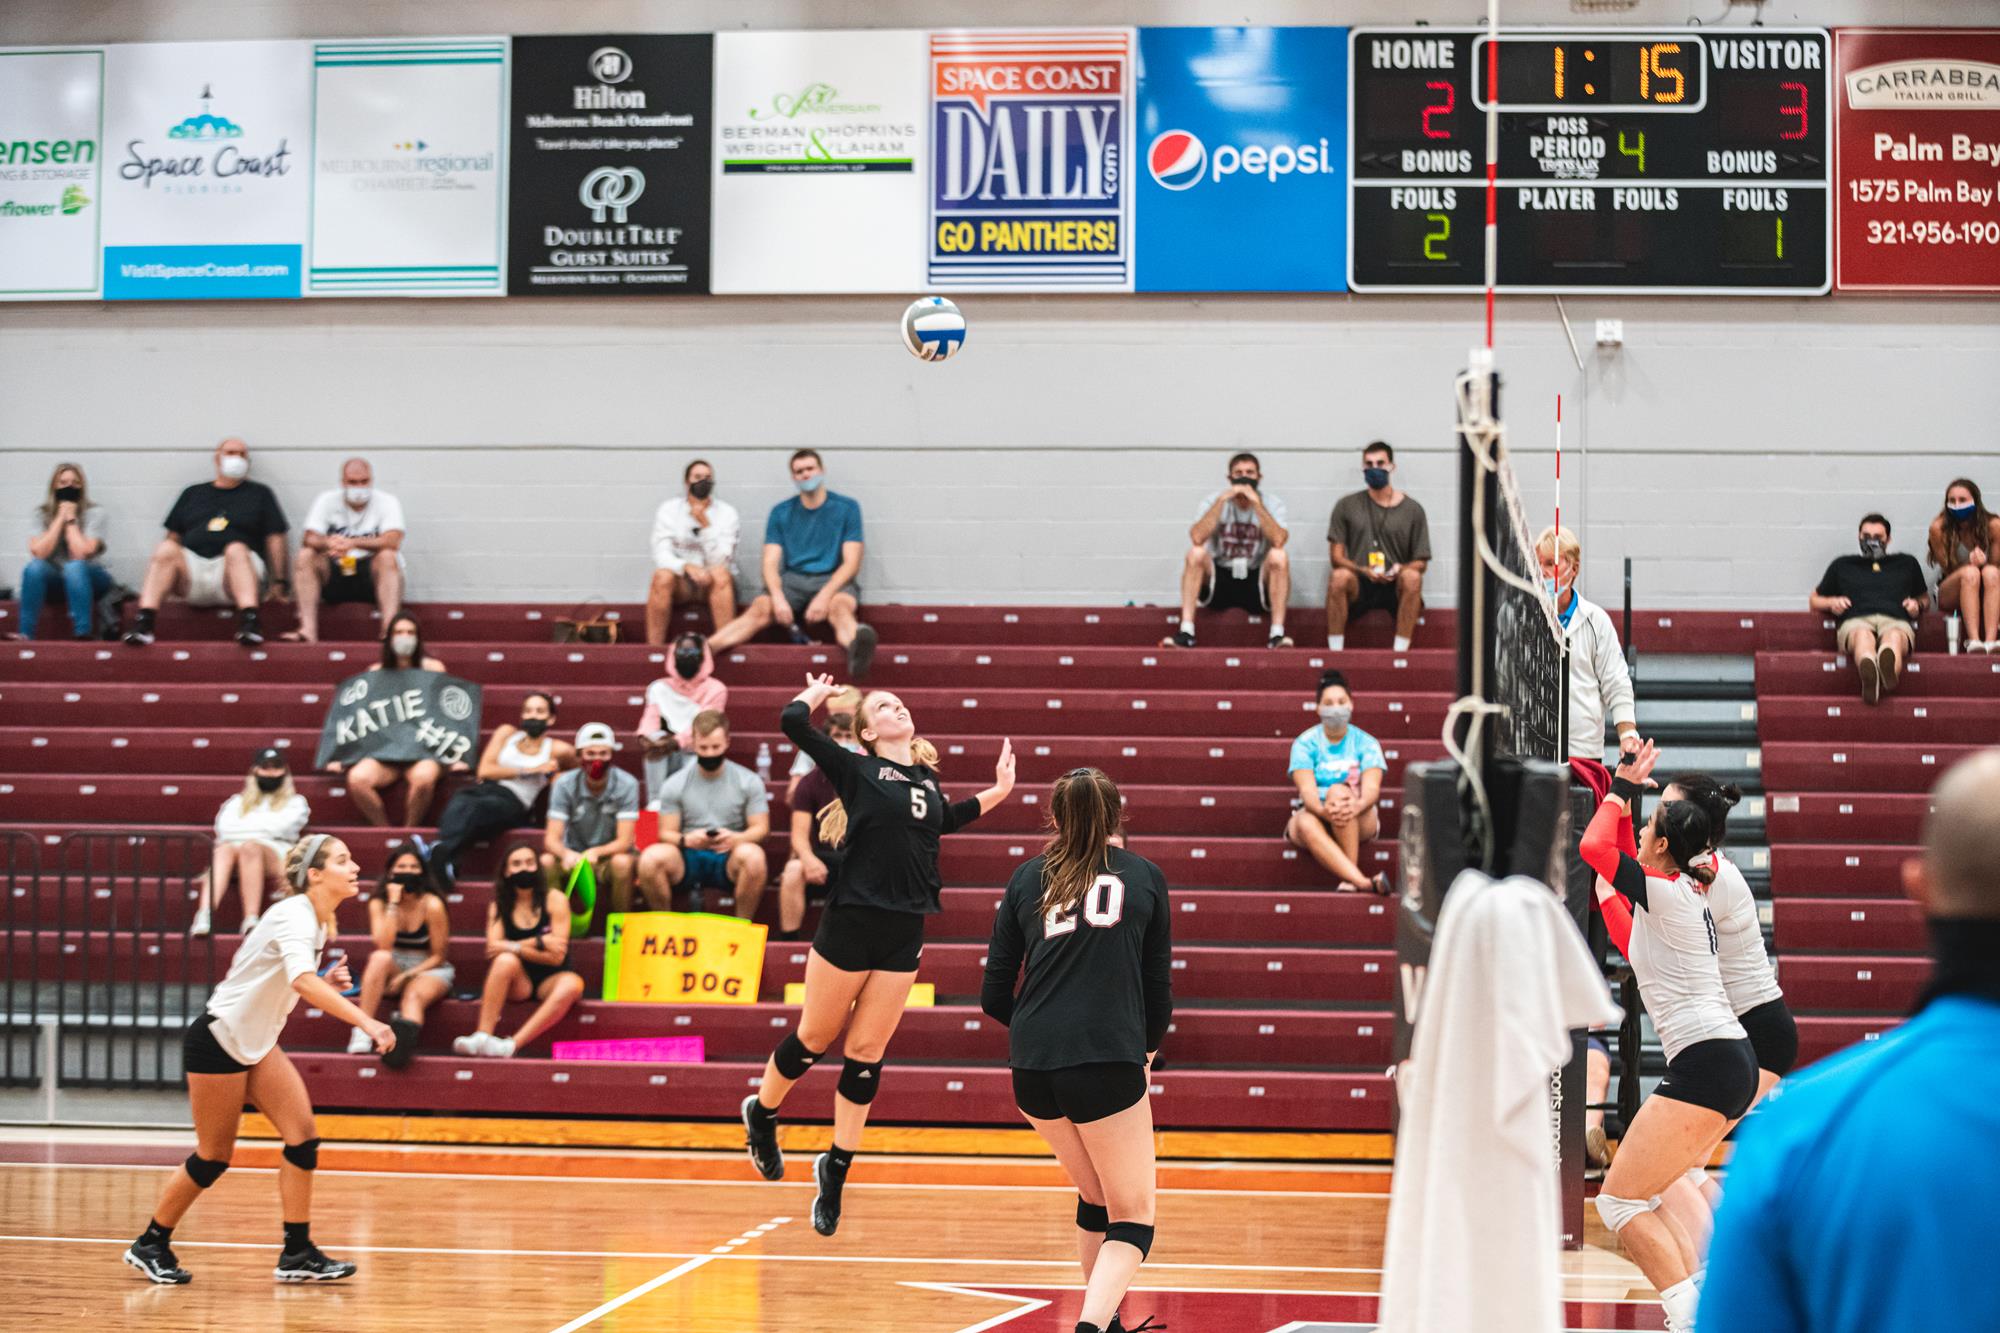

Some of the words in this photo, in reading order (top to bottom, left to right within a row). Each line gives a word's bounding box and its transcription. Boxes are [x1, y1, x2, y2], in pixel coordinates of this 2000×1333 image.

[1371, 39, 1455, 69] HOME
[1710, 39, 1821, 69] VISITOR
[942, 67, 1022, 91] SPACE
[1025, 66, 1116, 90] COAST
[573, 85, 646, 109] Hilton
[1894, 92, 1943, 100] ITALIAN
[590, 113, 626, 127] Beach
[1422, 81, 1455, 139] 2
[1779, 81, 1809, 140] 3
[1547, 117, 1589, 135] POSS
[722, 127, 806, 139] BERMAN
[804, 128, 833, 160] &
[828, 125, 916, 137] HOPKINS
[725, 143, 803, 155] WRIGHT
[838, 142, 904, 154] LAHAM
[941, 105, 1117, 200] DAILY
[1103, 143, 1118, 199] .com
[1530, 136, 1606, 158] PERIOD
[1618, 130, 1645, 172] 4
[1874, 133, 1943, 161] Palm
[1952, 134, 2000, 167] Bay
[119, 139, 204, 188] Space
[213, 138, 291, 177] Coast
[416, 152, 494, 176] regional
[1212, 138, 1330, 183] pepsi
[1401, 150, 1472, 173] BONUS
[1707, 150, 1777, 174] BONUS
[1390, 187, 1457, 210] FOULS
[1518, 188, 1596, 210] PLAYER
[1613, 188, 1679, 211] FOULS
[1723, 188, 1788, 211] FOULS
[1849, 179, 1900, 202] 1575
[1904, 180, 1952, 202] Palm
[1957, 180, 1992, 207] Bay
[938, 221, 975, 251] GO
[981, 221, 1116, 251] PANTHERS!
[1423, 213, 1450, 260] 2
[1775, 216, 1783, 260] 1
[1867, 220, 2000, 244] 321-956-190
[550, 250, 607, 266] GUEST
[336, 689, 426, 745] KATIE
[415, 717, 471, 764] #13
[910, 787, 928, 820] 5
[641, 935, 698, 957] MAD
[728, 943, 739, 956] 7
[681, 973, 741, 996] DOG
